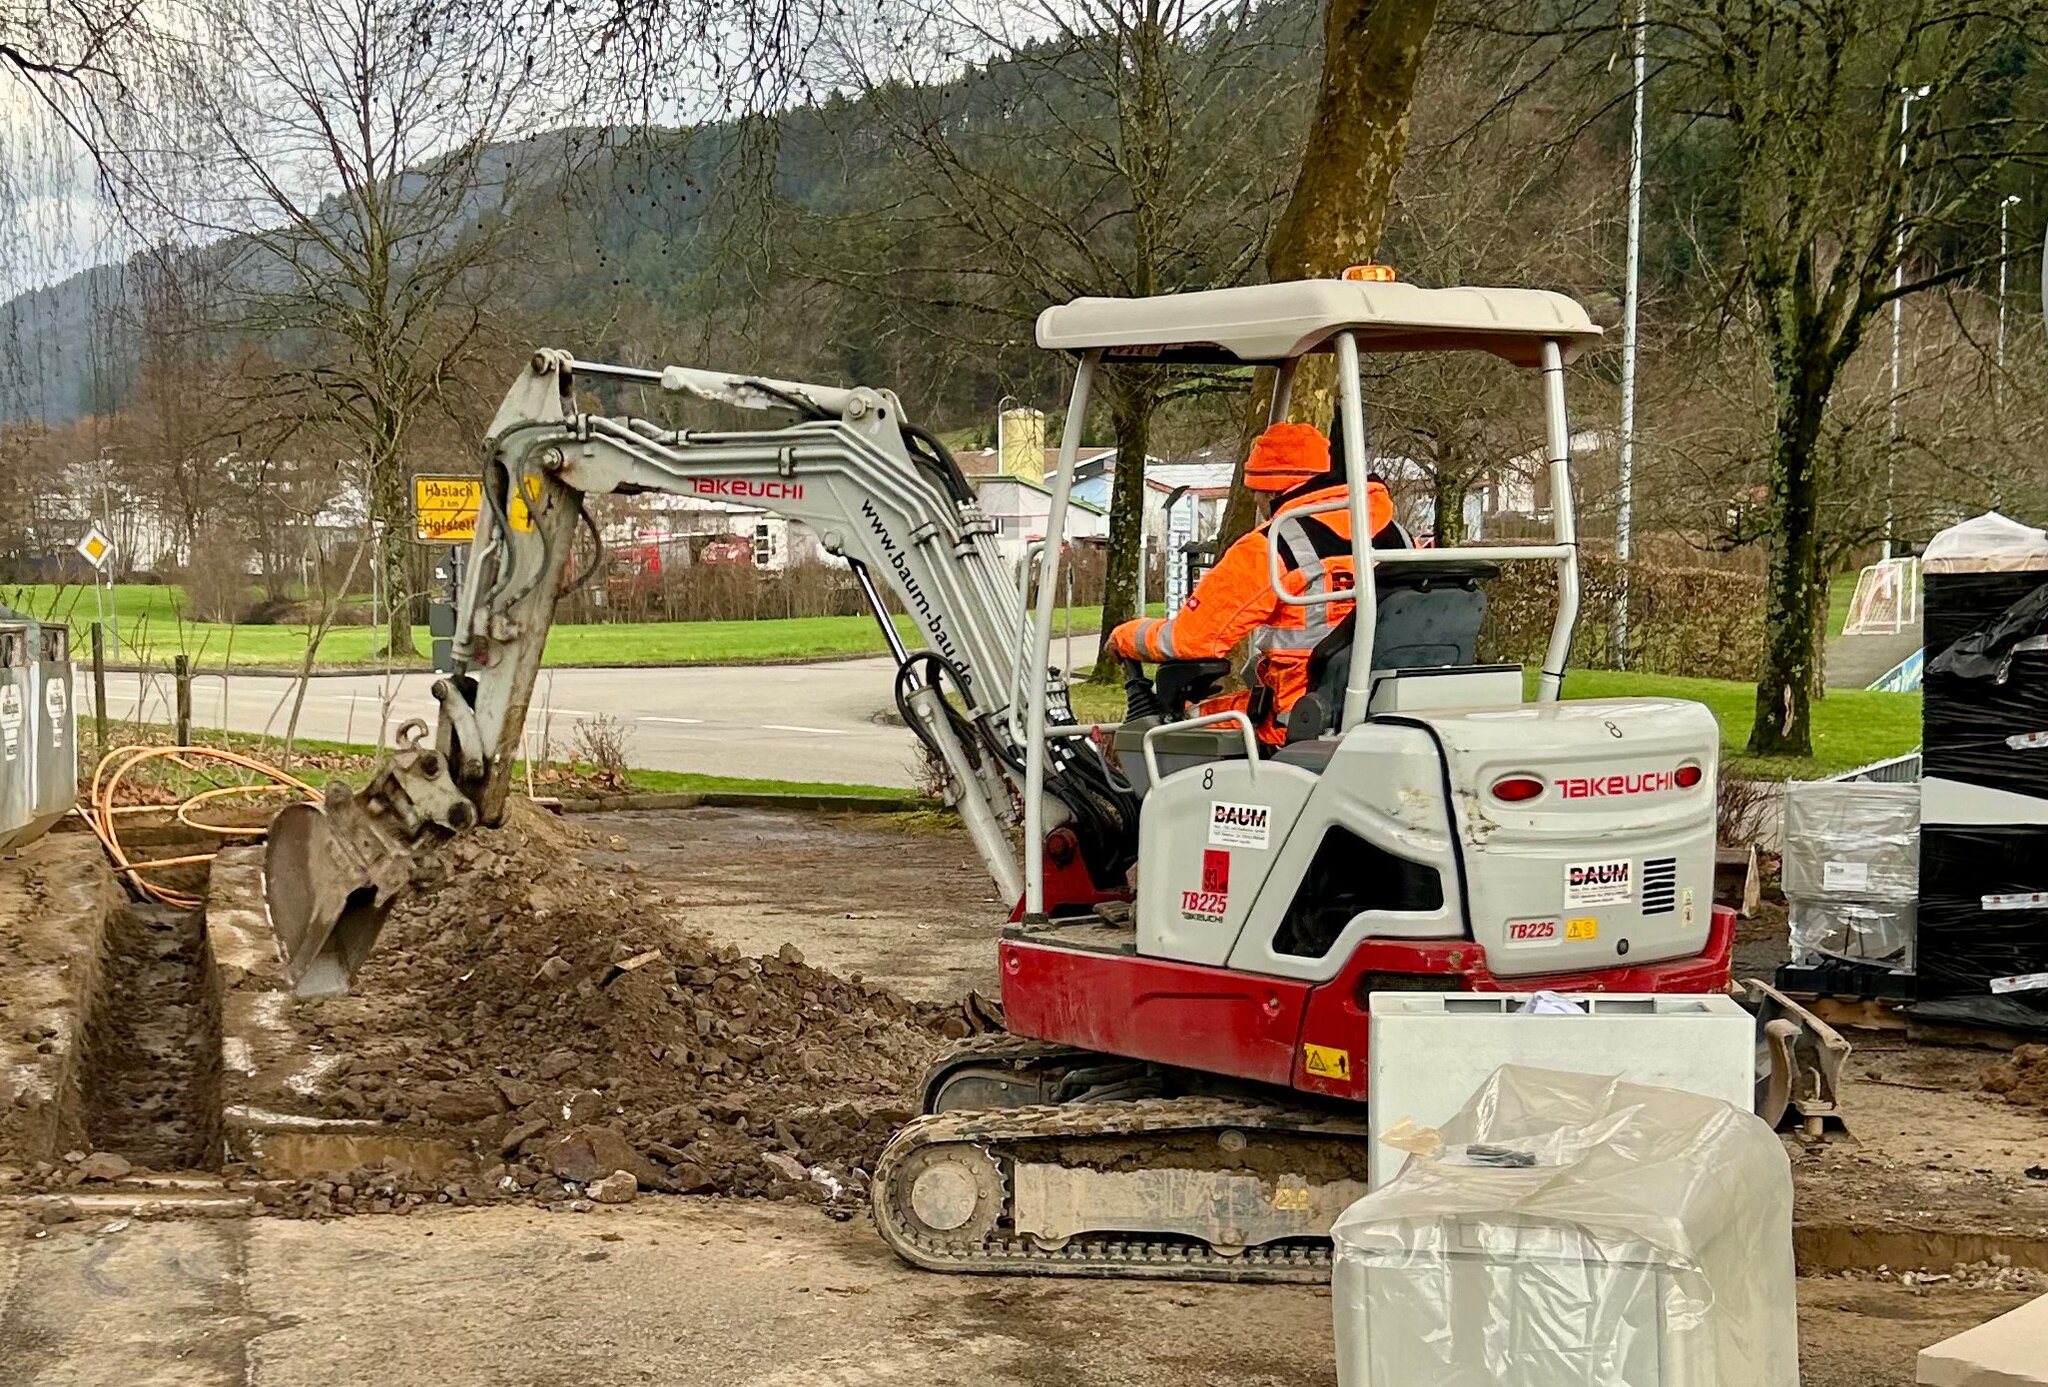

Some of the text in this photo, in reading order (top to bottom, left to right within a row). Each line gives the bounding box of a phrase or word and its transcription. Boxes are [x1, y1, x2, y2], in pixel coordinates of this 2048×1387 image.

[424, 517, 476, 531] Hofstett
[1604, 720, 1623, 739] 8
[1202, 767, 1214, 790] 8
[1214, 805, 1267, 828] BAUM
[1570, 862, 1628, 886] BAUM
[1181, 891, 1228, 914] TB225
[1509, 921, 1555, 939] TB225
